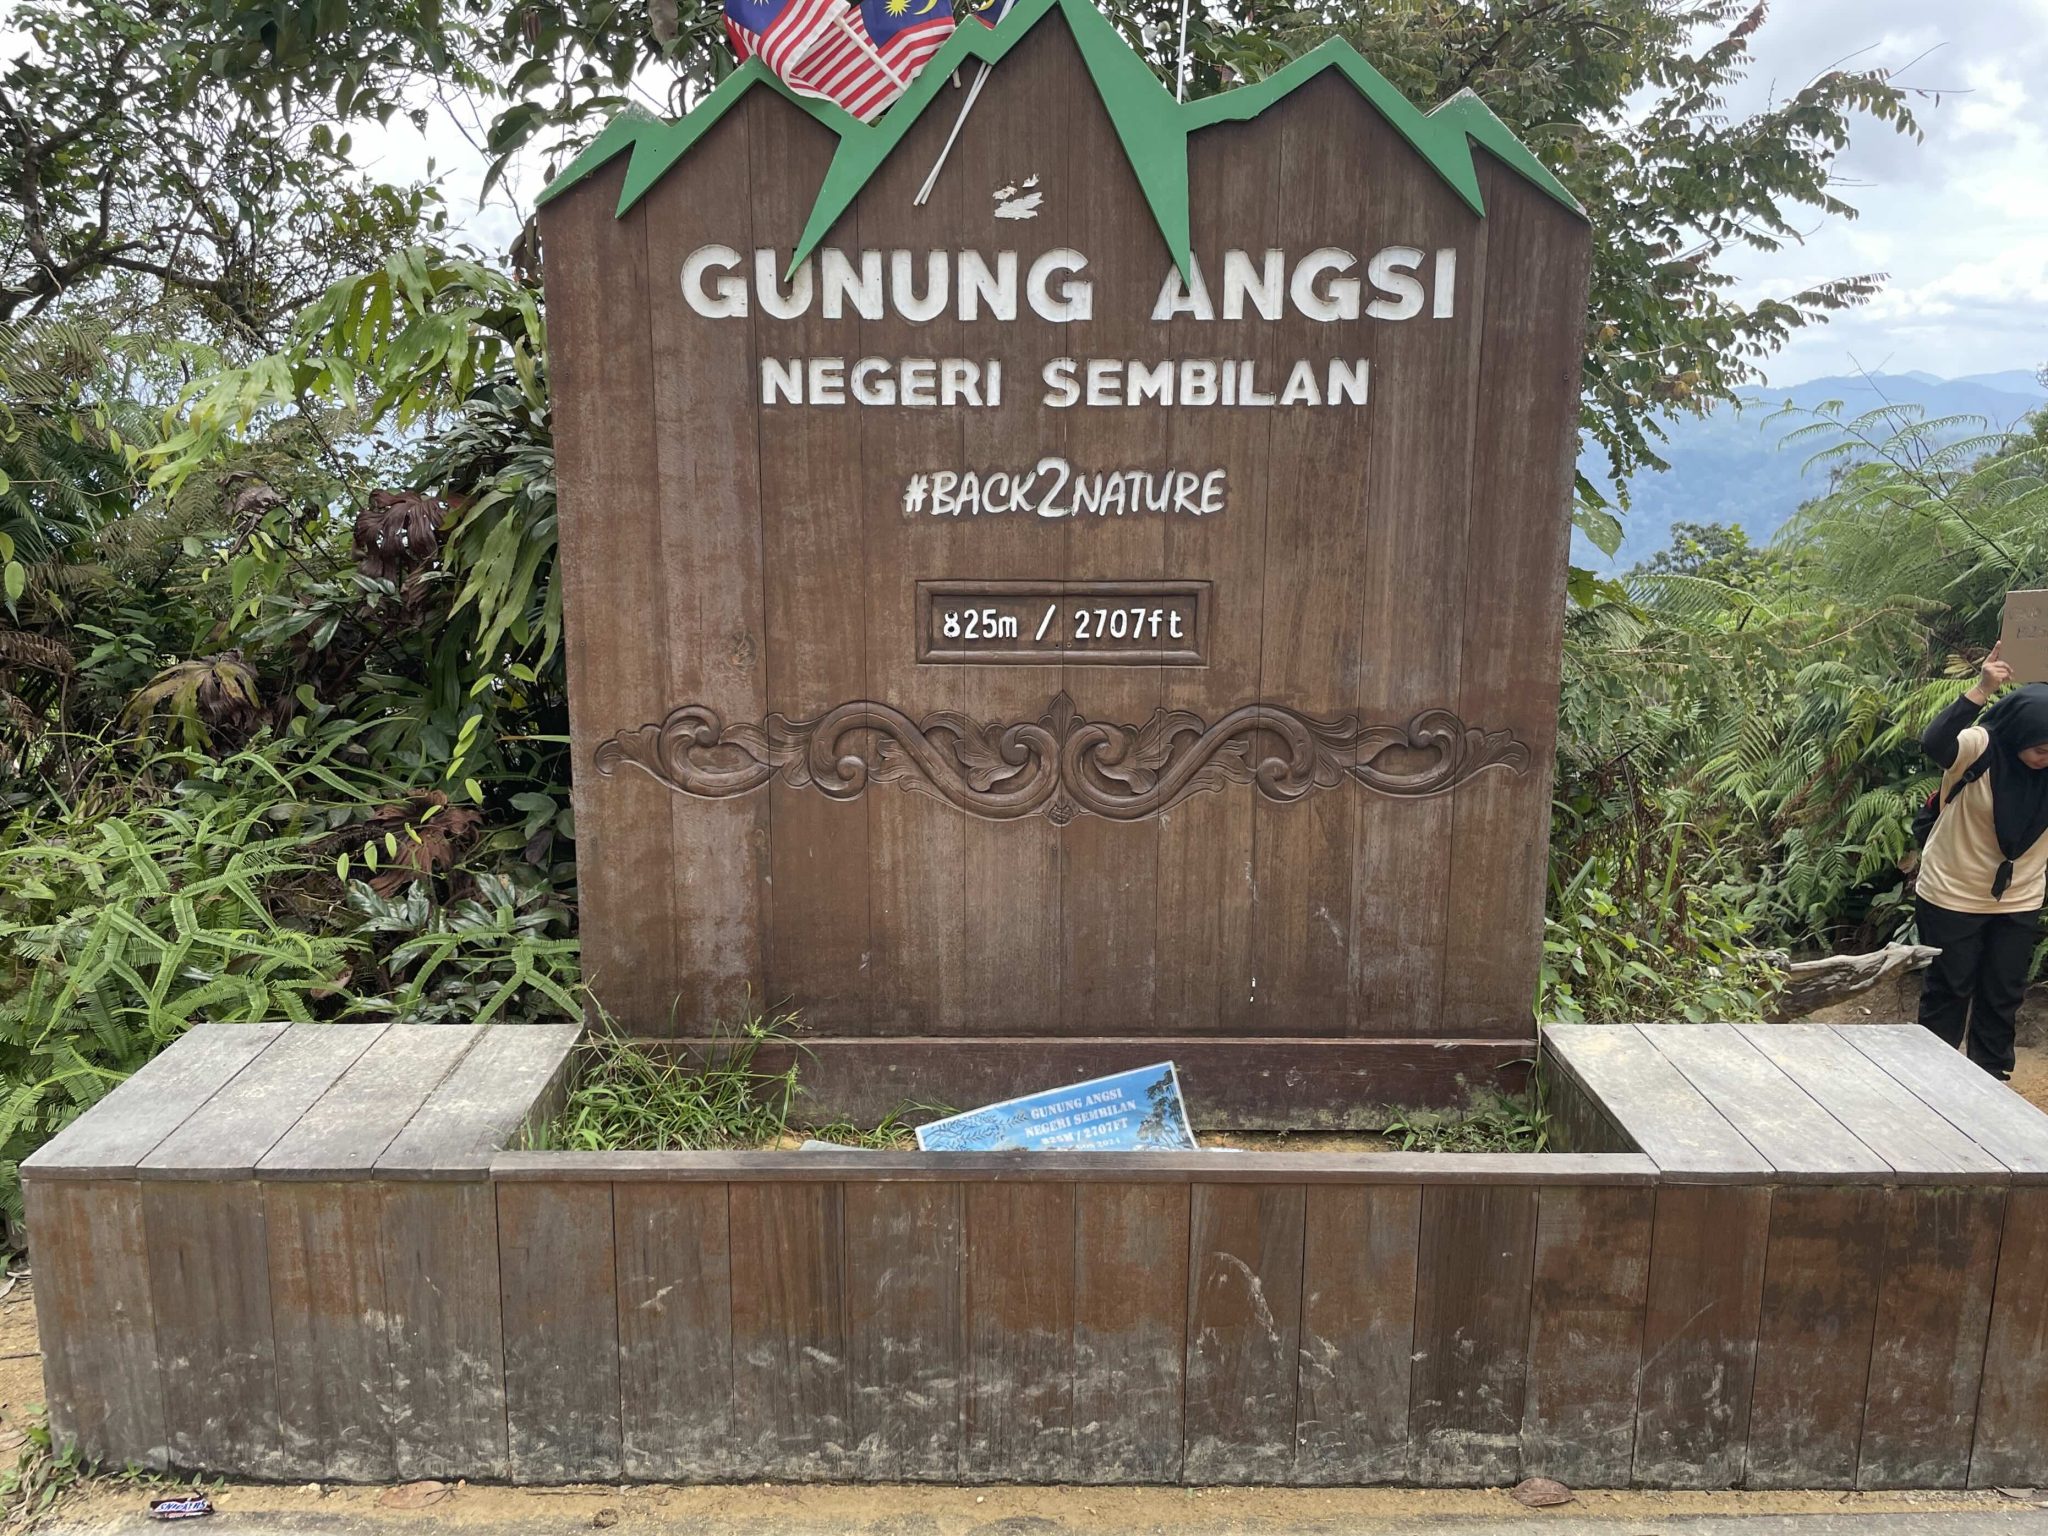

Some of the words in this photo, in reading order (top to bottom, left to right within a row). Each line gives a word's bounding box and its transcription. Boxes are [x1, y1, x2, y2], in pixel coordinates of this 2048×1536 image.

[680, 244, 1092, 322] GUNUNG
[1151, 246, 1457, 321] ANGSI
[762, 357, 1001, 405] NEGERI
[1042, 357, 1369, 407] SEMBILAN
[903, 456, 1226, 518] #BACK2NATURE
[943, 608, 1018, 639] 825m
[1035, 604, 1056, 641] /
[1074, 608, 1184, 639] 2707ft
[1024, 1116, 1072, 1138] NEGERI
[1073, 1100, 1137, 1126] SEMBILAN
[1030, 1098, 1083, 1120] GUNUNG
[1085, 1088, 1123, 1106] ANGSI
[1083, 1117, 1129, 1139] 2707FT
